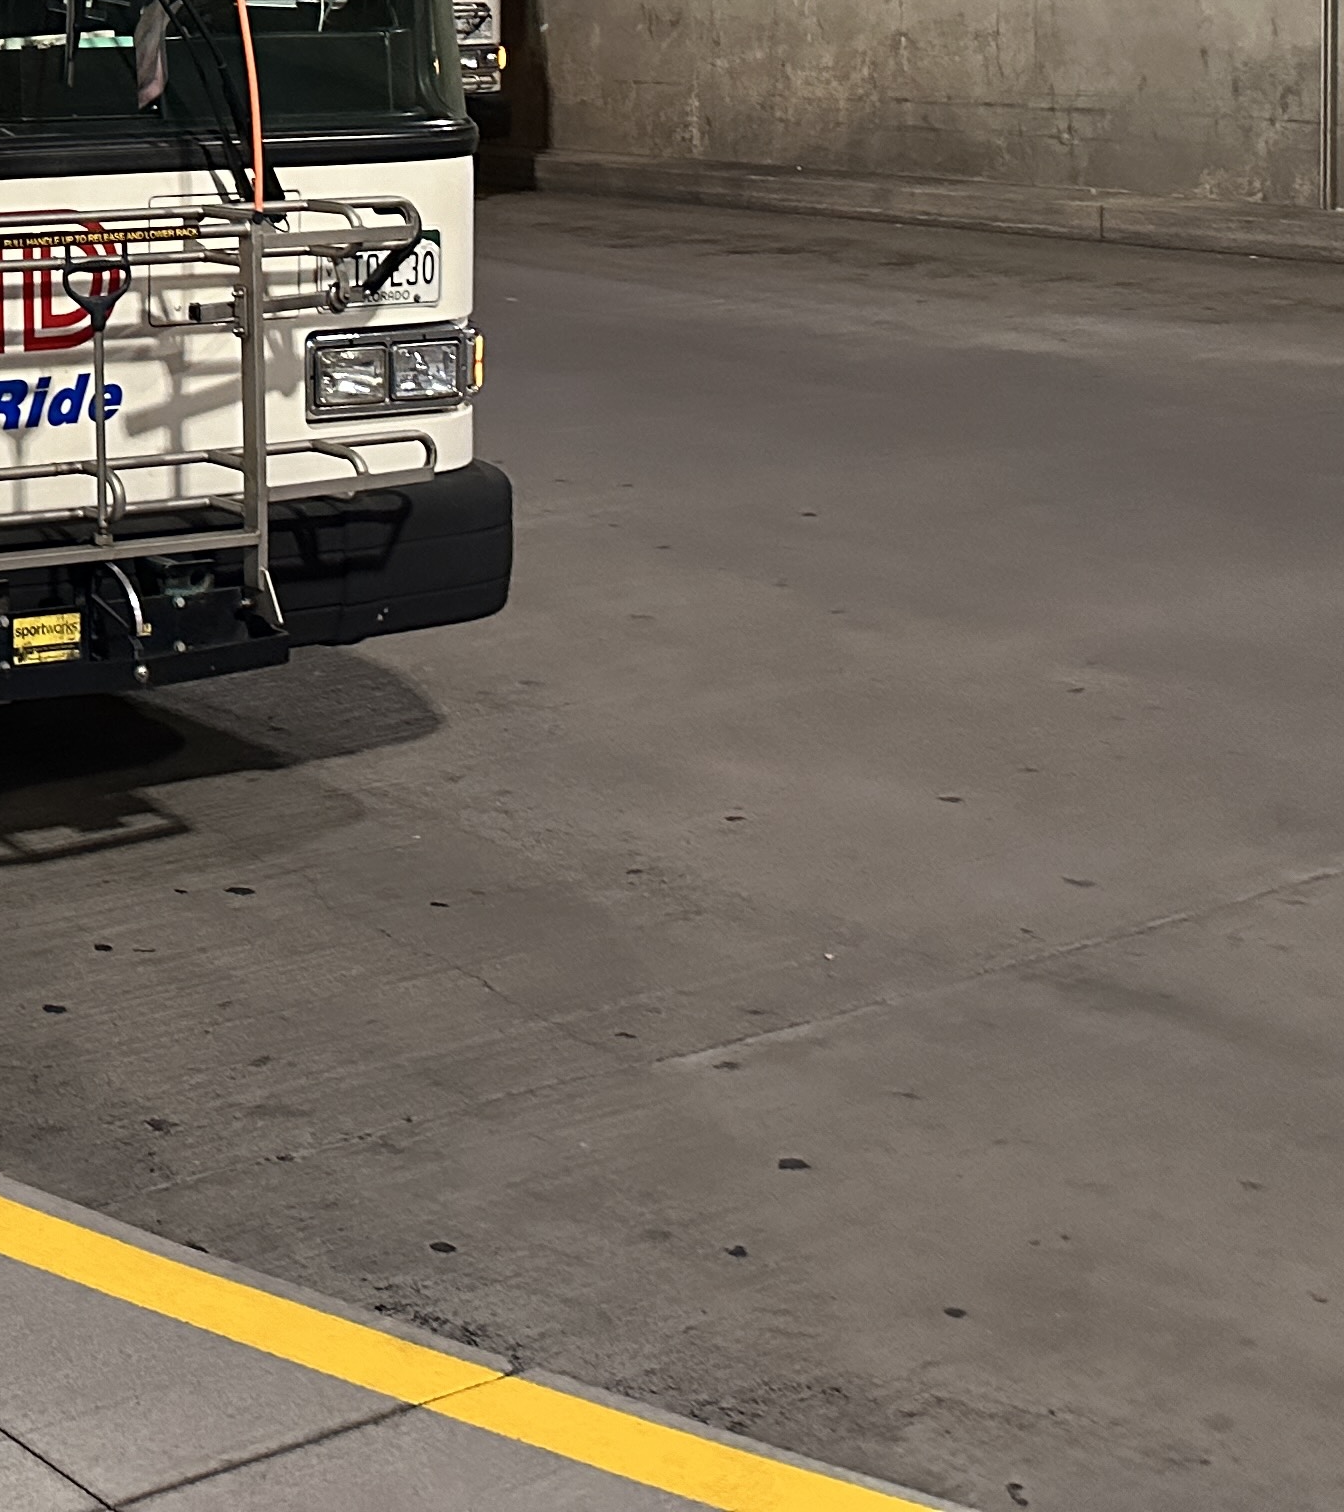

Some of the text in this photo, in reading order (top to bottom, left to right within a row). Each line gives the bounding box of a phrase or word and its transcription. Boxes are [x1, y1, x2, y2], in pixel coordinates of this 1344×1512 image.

[3, 238, 25, 248] PULL
[25, 236, 60, 247] HANDLE
[60, 235, 74, 245] UP
[74, 234, 87, 243] TO
[87, 232, 125, 243] RELEASE
[126, 230, 144, 240] AND
[144, 229, 175, 240] LOWER
[175, 227, 199, 237] RACK
[15, 620, 79, 640] sportworks
